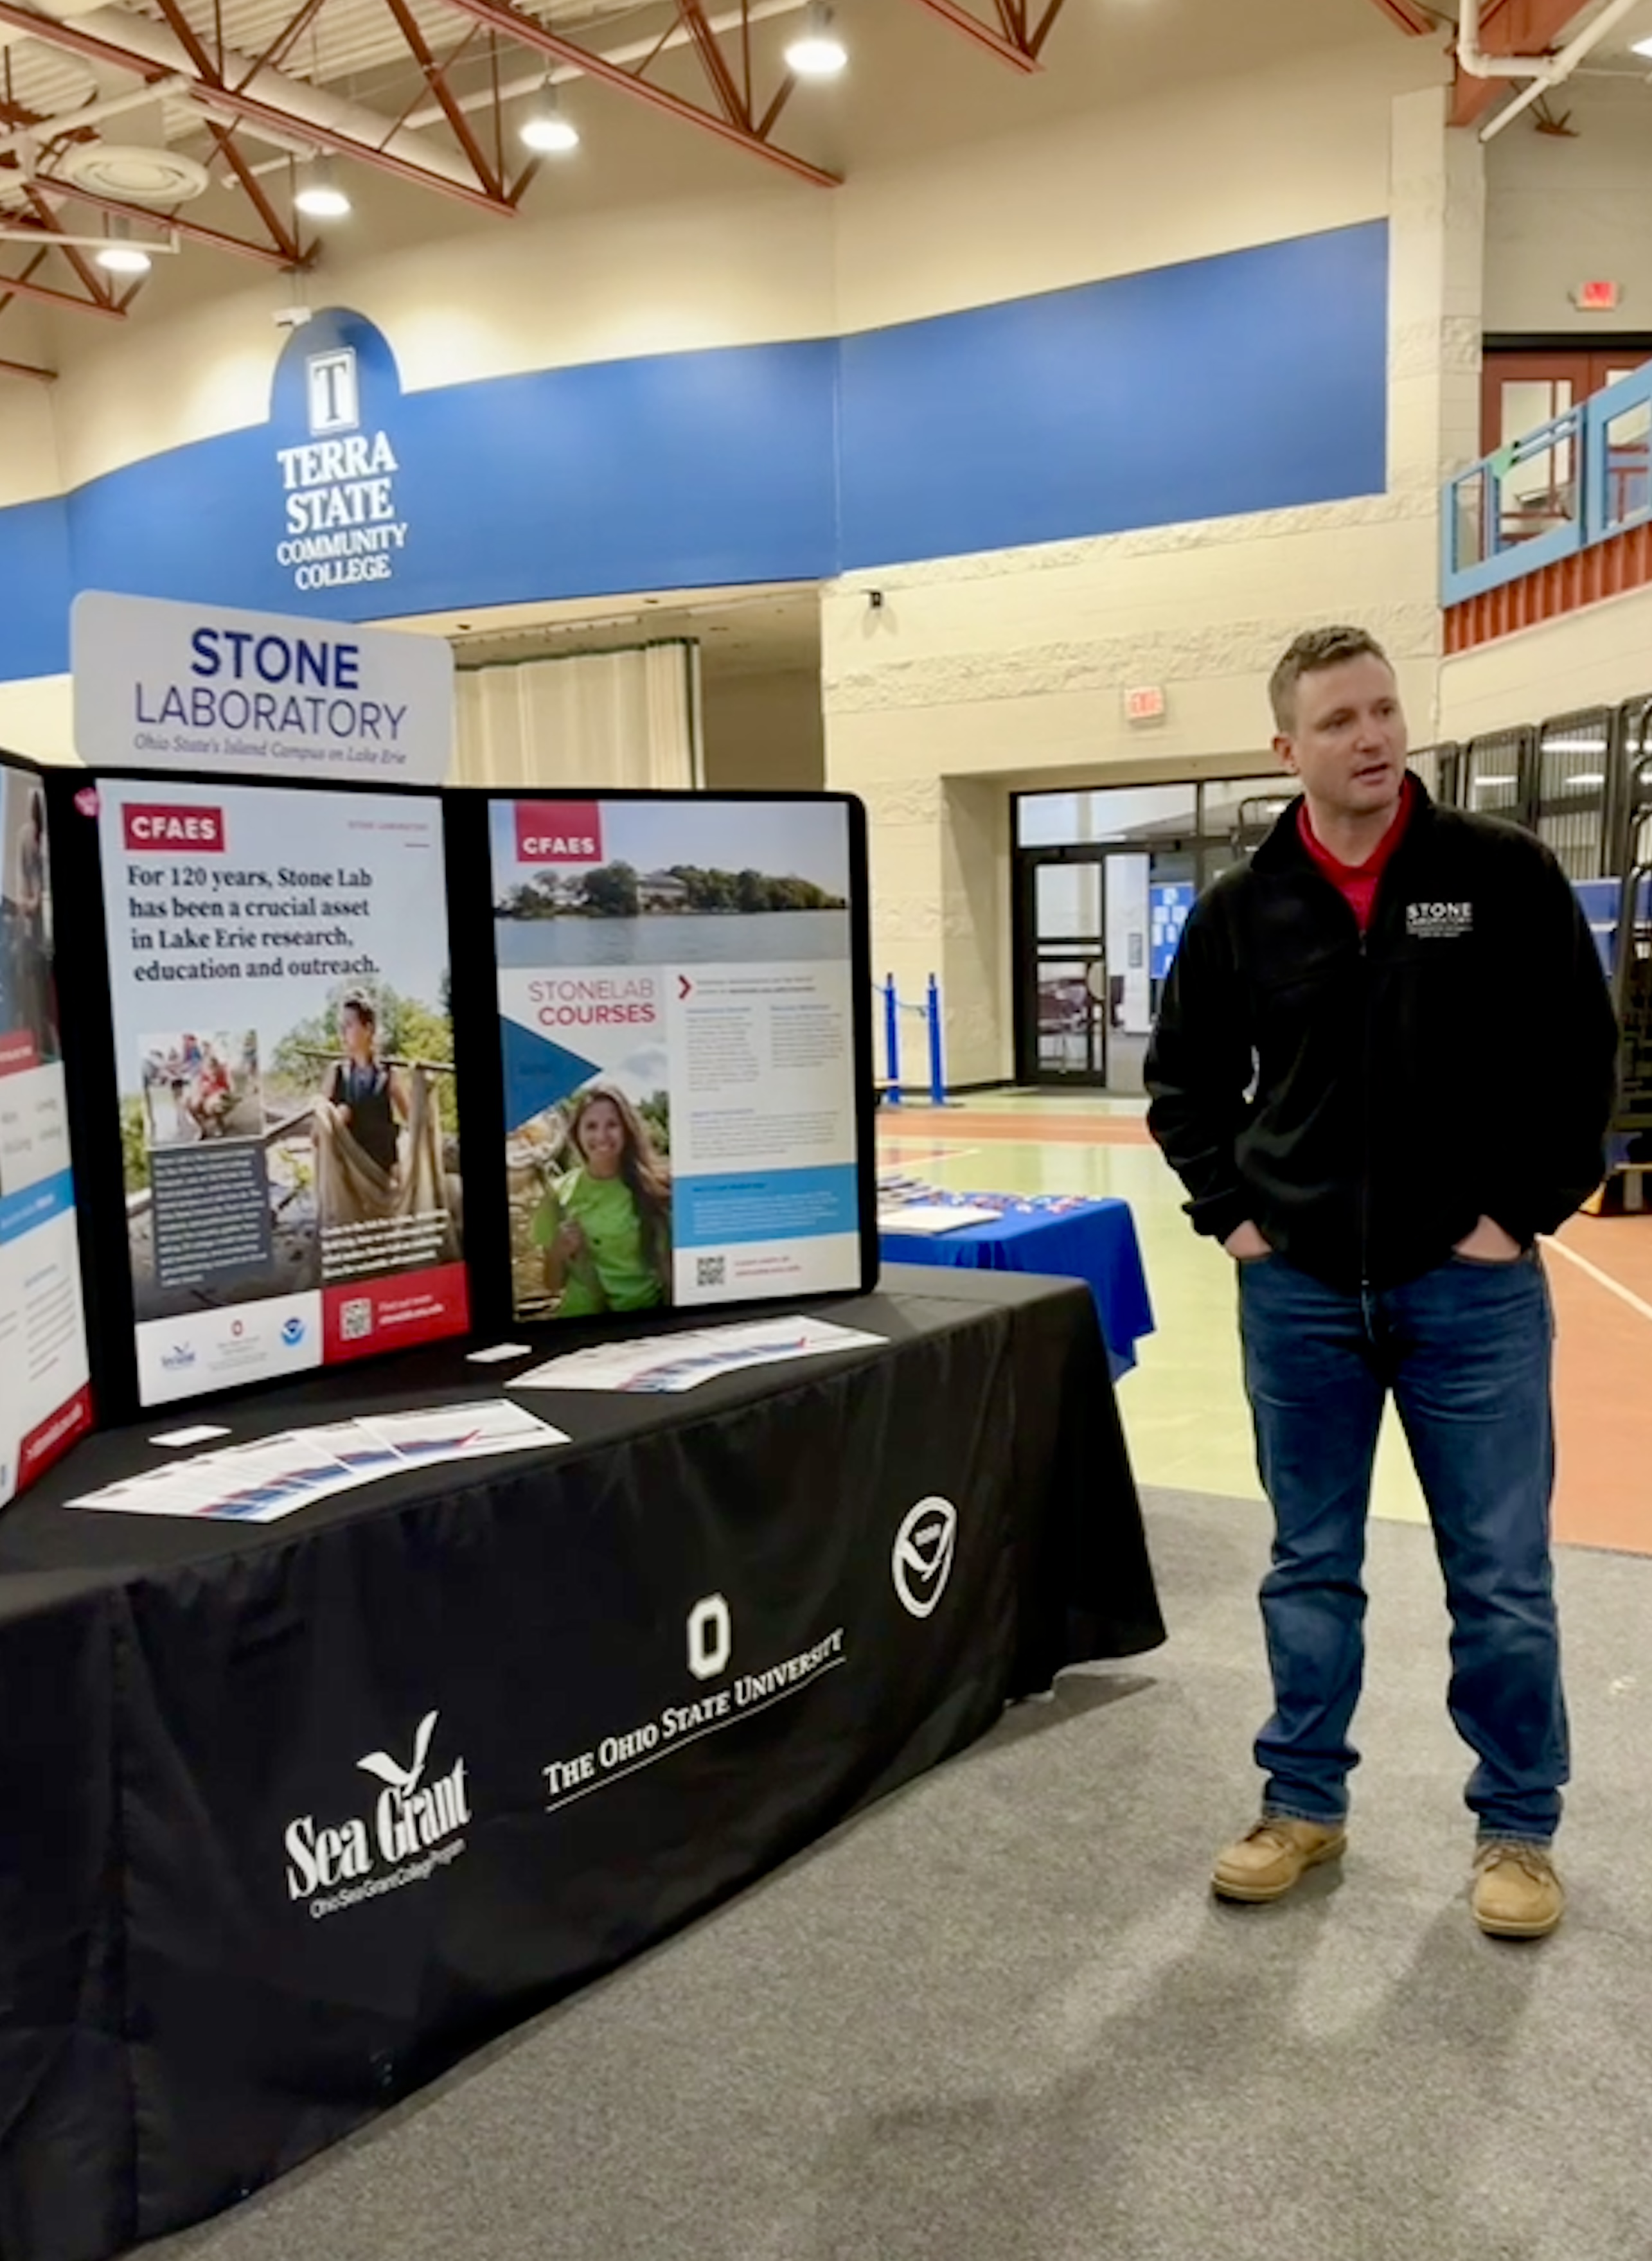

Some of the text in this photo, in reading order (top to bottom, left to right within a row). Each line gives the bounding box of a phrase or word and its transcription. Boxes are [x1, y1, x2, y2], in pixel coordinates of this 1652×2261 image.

[314, 360, 347, 421] T
[276, 430, 398, 490] TERRA
[286, 477, 395, 535] STATE
[277, 522, 408, 566] COMMUNITY
[294, 555, 392, 590] COLLEGE
[191, 627, 359, 690] STONE
[136, 682, 407, 740] LABORATORY
[130, 817, 217, 840] CFAES
[522, 837, 595, 855] CFAES
[127, 865, 373, 891] For 120 years, Stone Lab
[130, 898, 370, 918] has been a crucial asset
[132, 927, 353, 950] in Lake Erie research,
[134, 955, 380, 982] education and outreach.
[529, 979, 654, 1003] STONELAB
[538, 1004, 656, 1026] COURSES
[542, 1626, 844, 1795] THE OHIO STATE UNIVERSITY
[285, 1755, 473, 1901] Sea Grant
